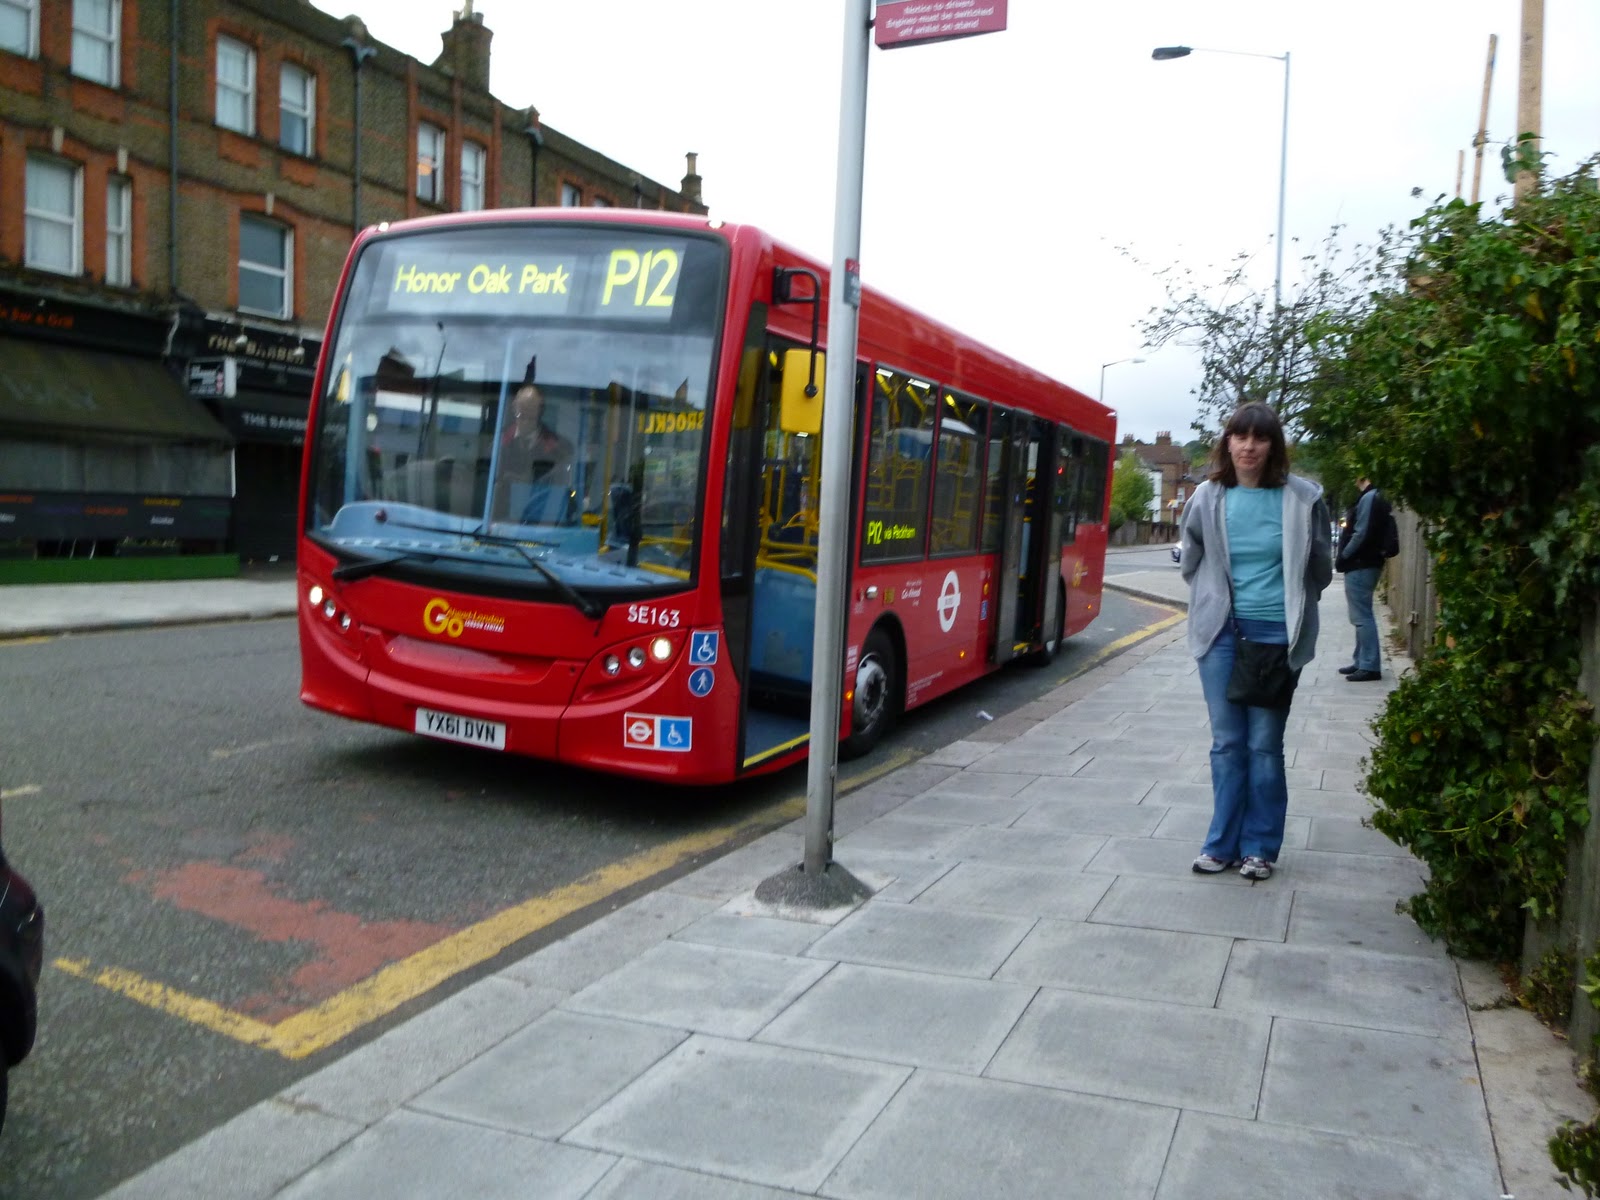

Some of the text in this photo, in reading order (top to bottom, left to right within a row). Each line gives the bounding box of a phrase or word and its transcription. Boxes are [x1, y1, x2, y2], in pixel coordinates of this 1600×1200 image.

[395, 264, 569, 294] Honor Oak Park
[601, 248, 678, 307] P12
[867, 520, 883, 545] P12
[424, 597, 464, 638] Go
[627, 604, 681, 628] SE163
[426, 711, 495, 743] YX61 DVN
